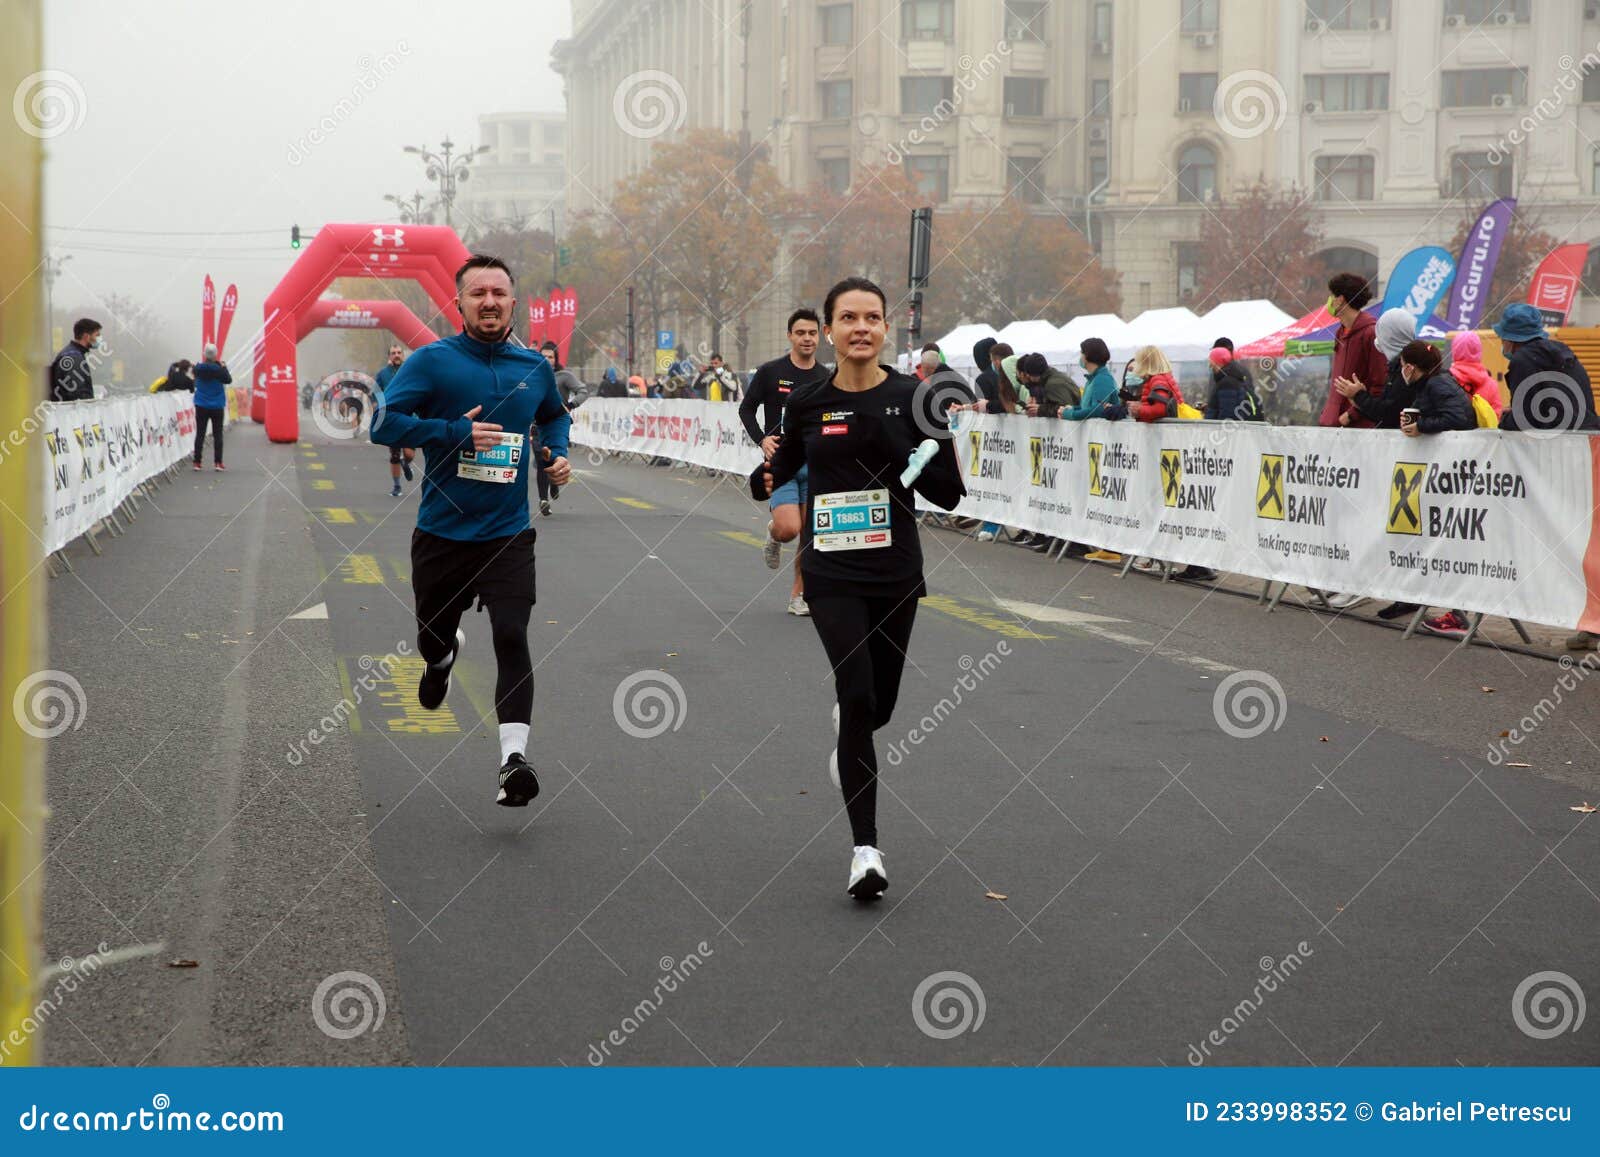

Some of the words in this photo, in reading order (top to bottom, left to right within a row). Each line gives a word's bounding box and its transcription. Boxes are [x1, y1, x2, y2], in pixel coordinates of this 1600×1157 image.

[660, 332, 670, 344] P
[1286, 454, 1361, 489] Raiffeisen
[1425, 459, 1527, 499] Raiffeisen
[1101, 475, 1128, 502] BANK
[1177, 484, 1217, 512] BANK
[1288, 494, 1328, 527] BANK
[1428, 506, 1489, 541] BANK
[1389, 550, 1429, 576] Banking
[1453, 560, 1479, 576] cum
[1481, 559, 1518, 581] trebuie
